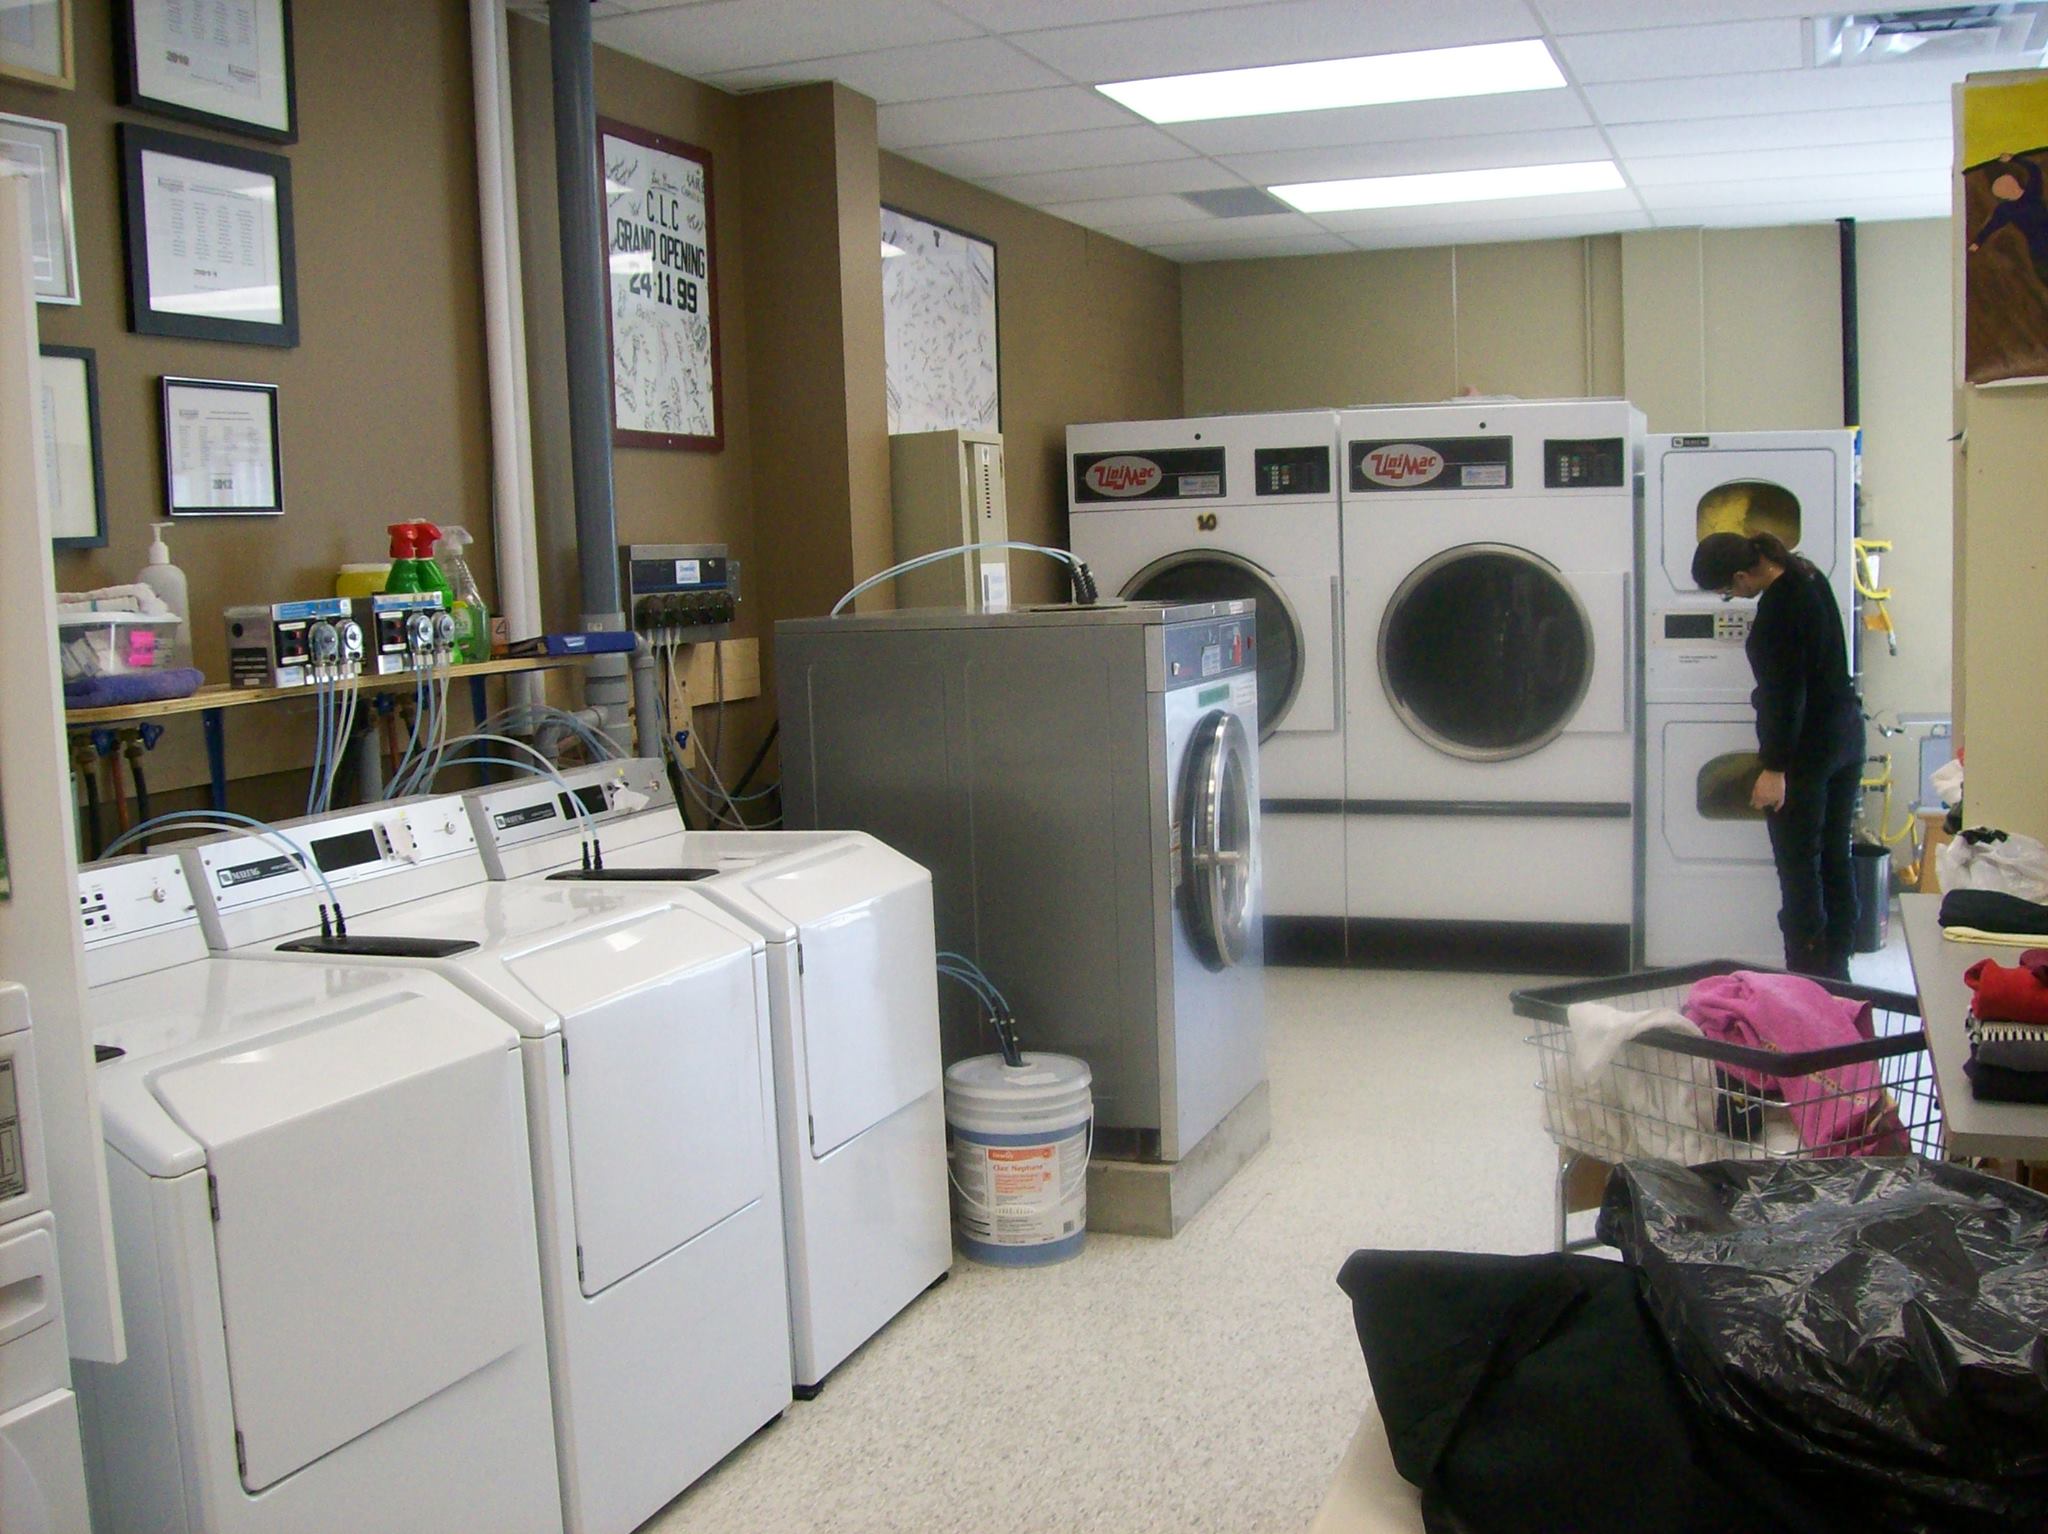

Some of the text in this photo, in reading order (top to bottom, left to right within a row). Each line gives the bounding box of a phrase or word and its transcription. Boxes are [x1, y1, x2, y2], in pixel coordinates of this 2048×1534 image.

[616, 217, 656, 261] GRAND
[659, 232, 705, 279] OPENING
[1093, 464, 1155, 490] UniMac
[1370, 452, 1437, 480] UniMac
